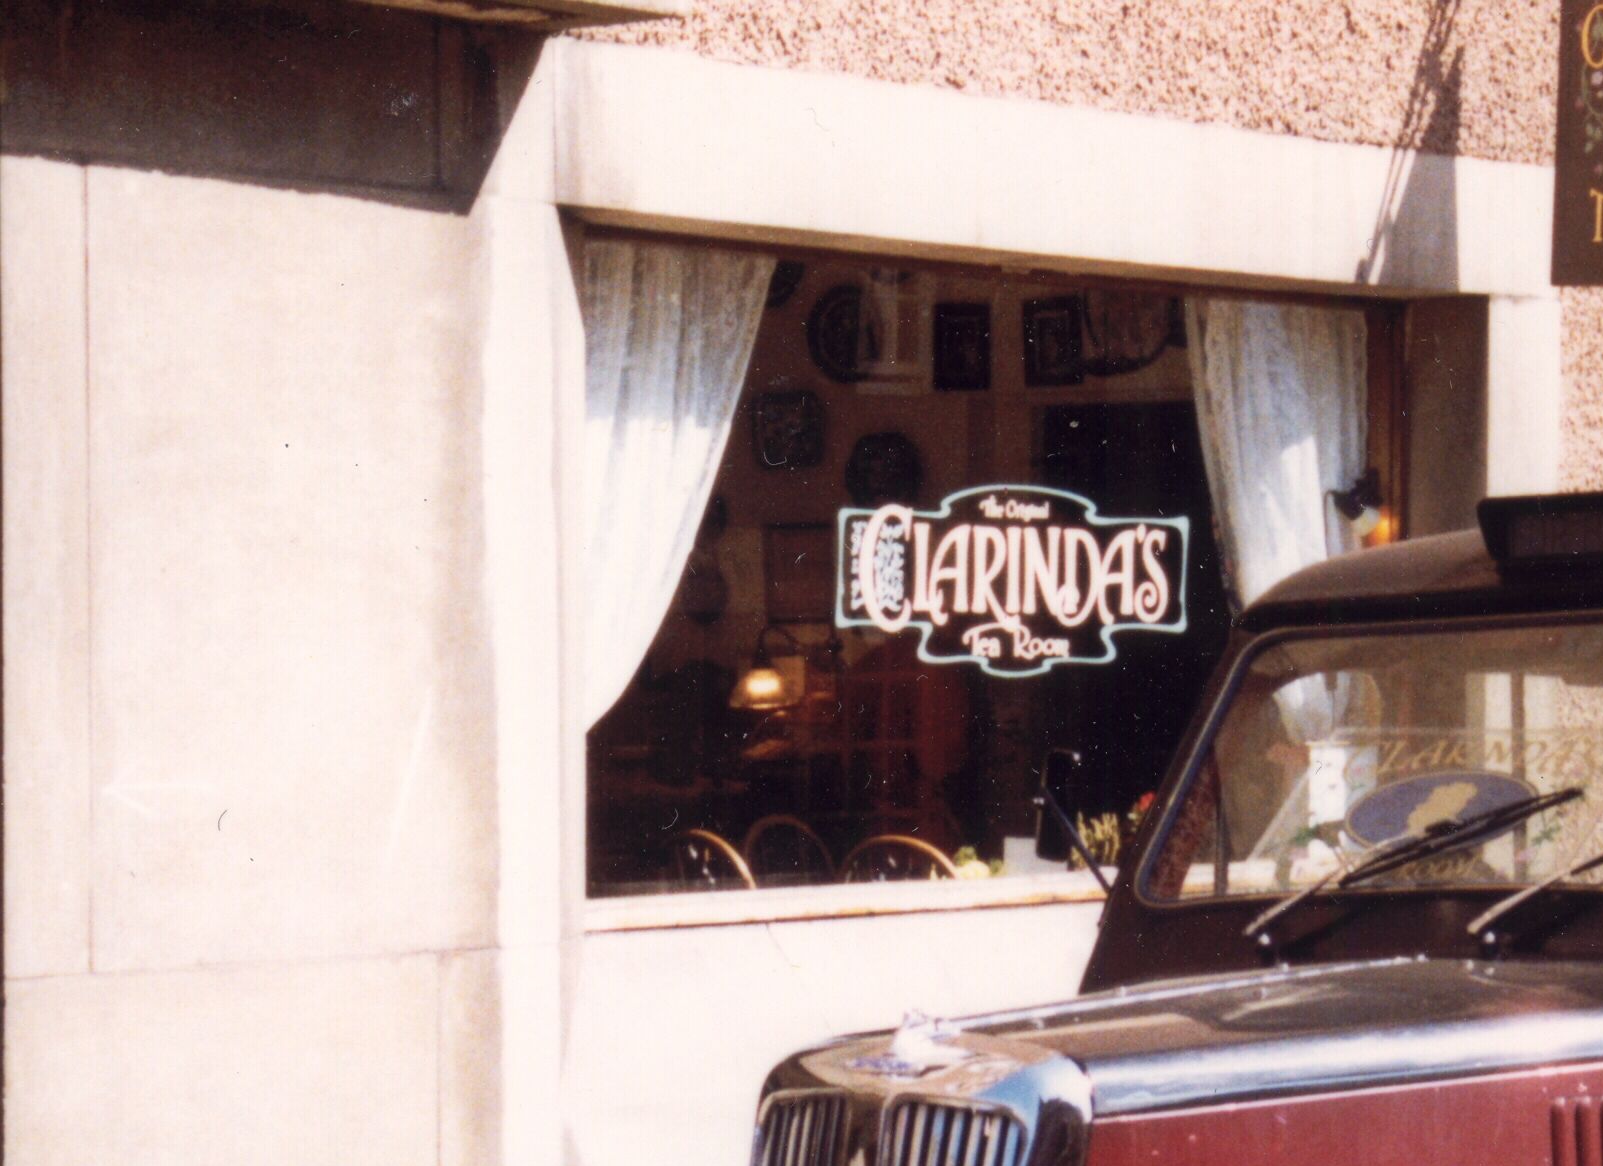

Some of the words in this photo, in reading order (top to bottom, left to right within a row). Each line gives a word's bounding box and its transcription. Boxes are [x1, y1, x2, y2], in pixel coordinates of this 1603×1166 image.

[859, 503, 1170, 632] CLARINDA'S
[961, 622, 1001, 658] Tea
[1012, 622, 1070, 660] Room
